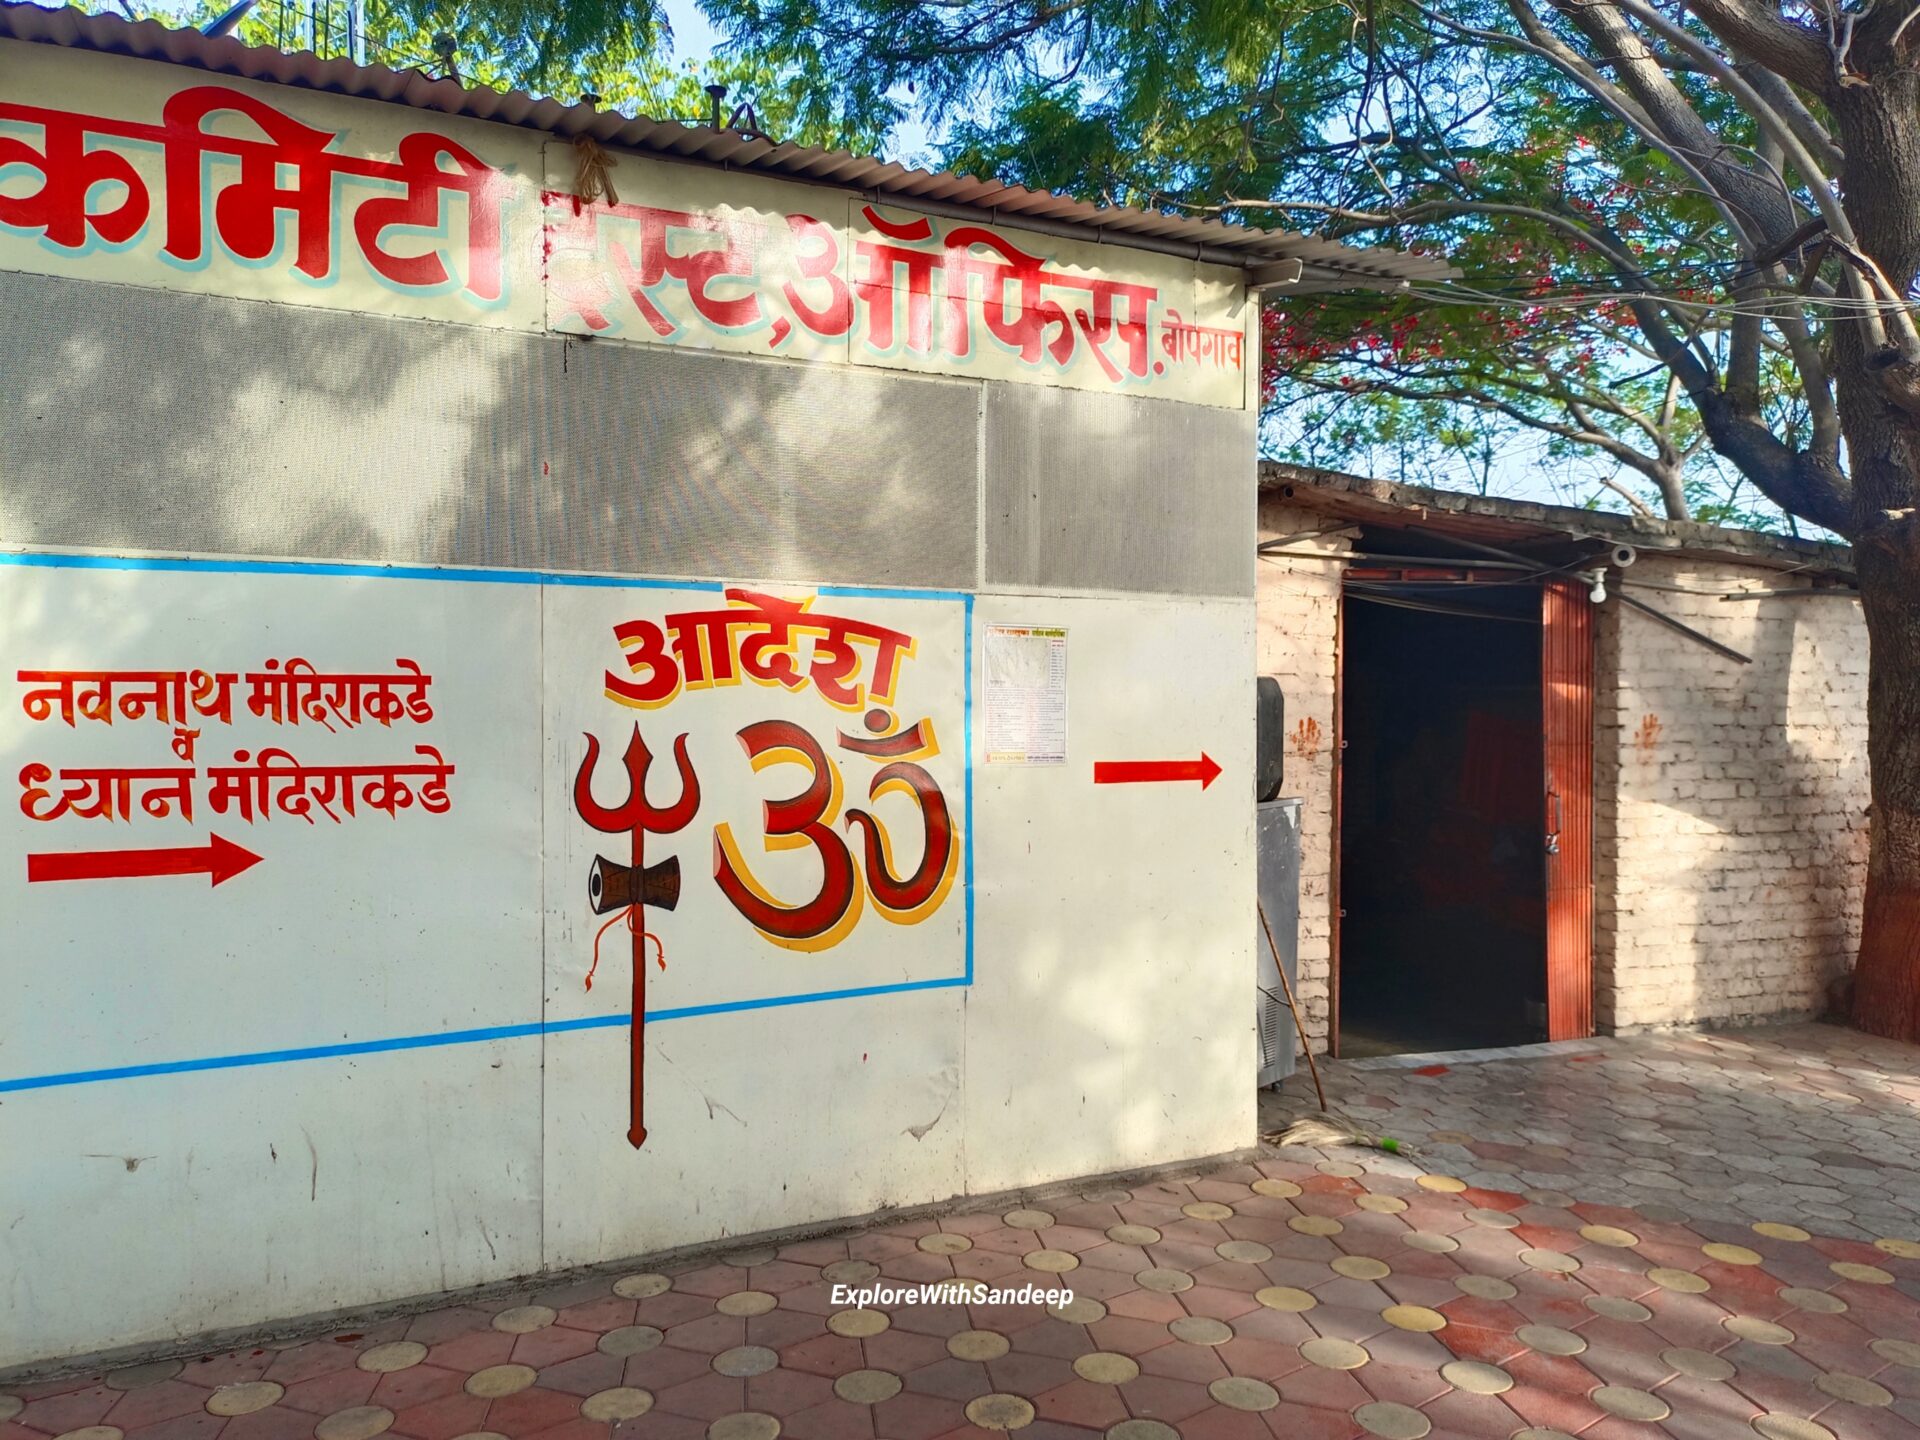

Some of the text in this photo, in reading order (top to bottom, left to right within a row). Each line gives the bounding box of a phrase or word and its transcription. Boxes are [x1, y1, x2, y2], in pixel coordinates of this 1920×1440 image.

[0, 86, 506, 301] कमिटी
[604, 588, 918, 708] आदेश
[17, 657, 434, 733] नवनाथ मंदिराकडे
[19, 744, 455, 826] ध्यान मंदिराकडे
[171, 727, 201, 764] व
